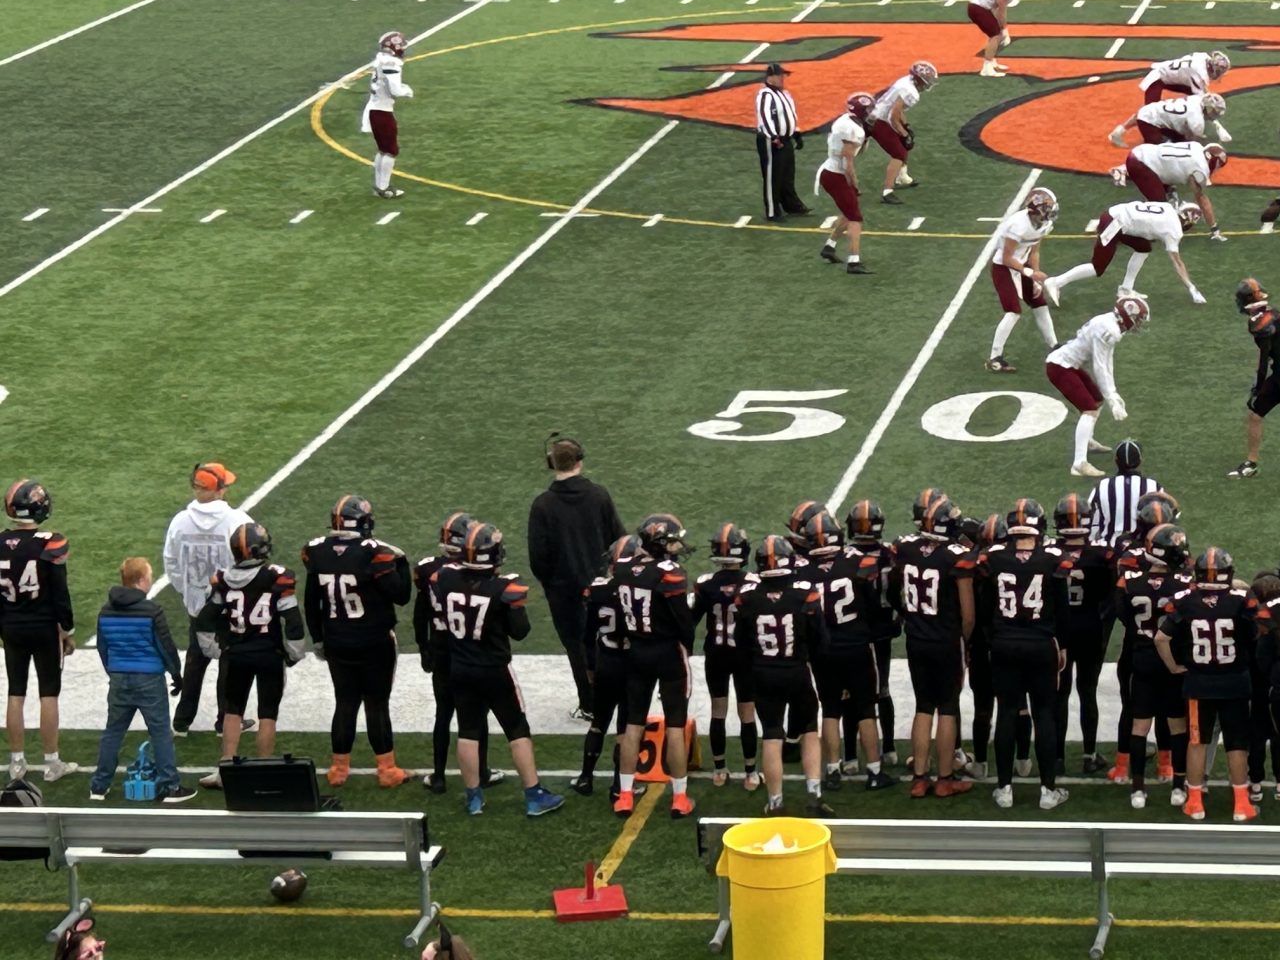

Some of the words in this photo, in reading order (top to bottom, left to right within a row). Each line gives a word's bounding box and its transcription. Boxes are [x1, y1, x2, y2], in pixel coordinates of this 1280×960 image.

[0, 560, 40, 603] 54
[318, 573, 365, 619] 76
[904, 563, 940, 616] 63
[997, 572, 1044, 620] 64
[225, 590, 272, 634] 34
[446, 591, 491, 640] 67
[756, 613, 795, 657] 61
[1190, 618, 1237, 665] 66
